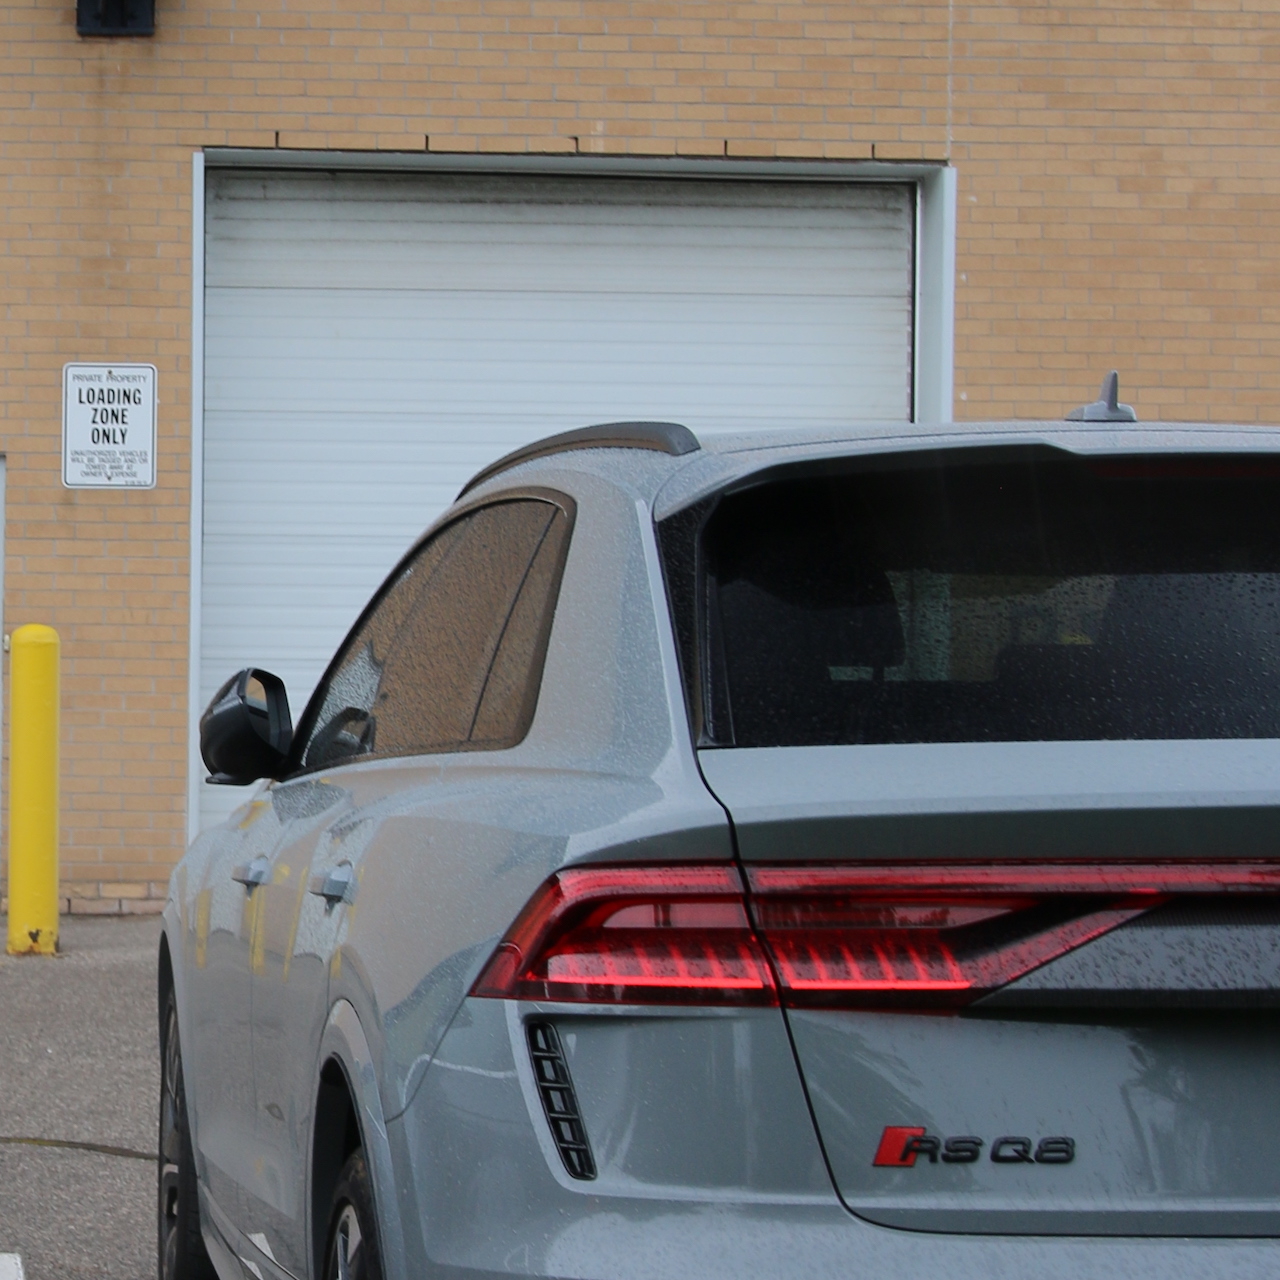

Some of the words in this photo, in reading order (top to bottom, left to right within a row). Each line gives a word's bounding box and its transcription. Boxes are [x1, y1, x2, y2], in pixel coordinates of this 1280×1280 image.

[72, 374, 103, 382] PRIVATE
[106, 374, 147, 383] PROPERTY
[78, 387, 142, 405] LOADING
[91, 408, 128, 425] ZONE
[91, 428, 127, 445] ONLY
[899, 1135, 983, 1163] RS
[990, 1136, 1076, 1164] Q8
